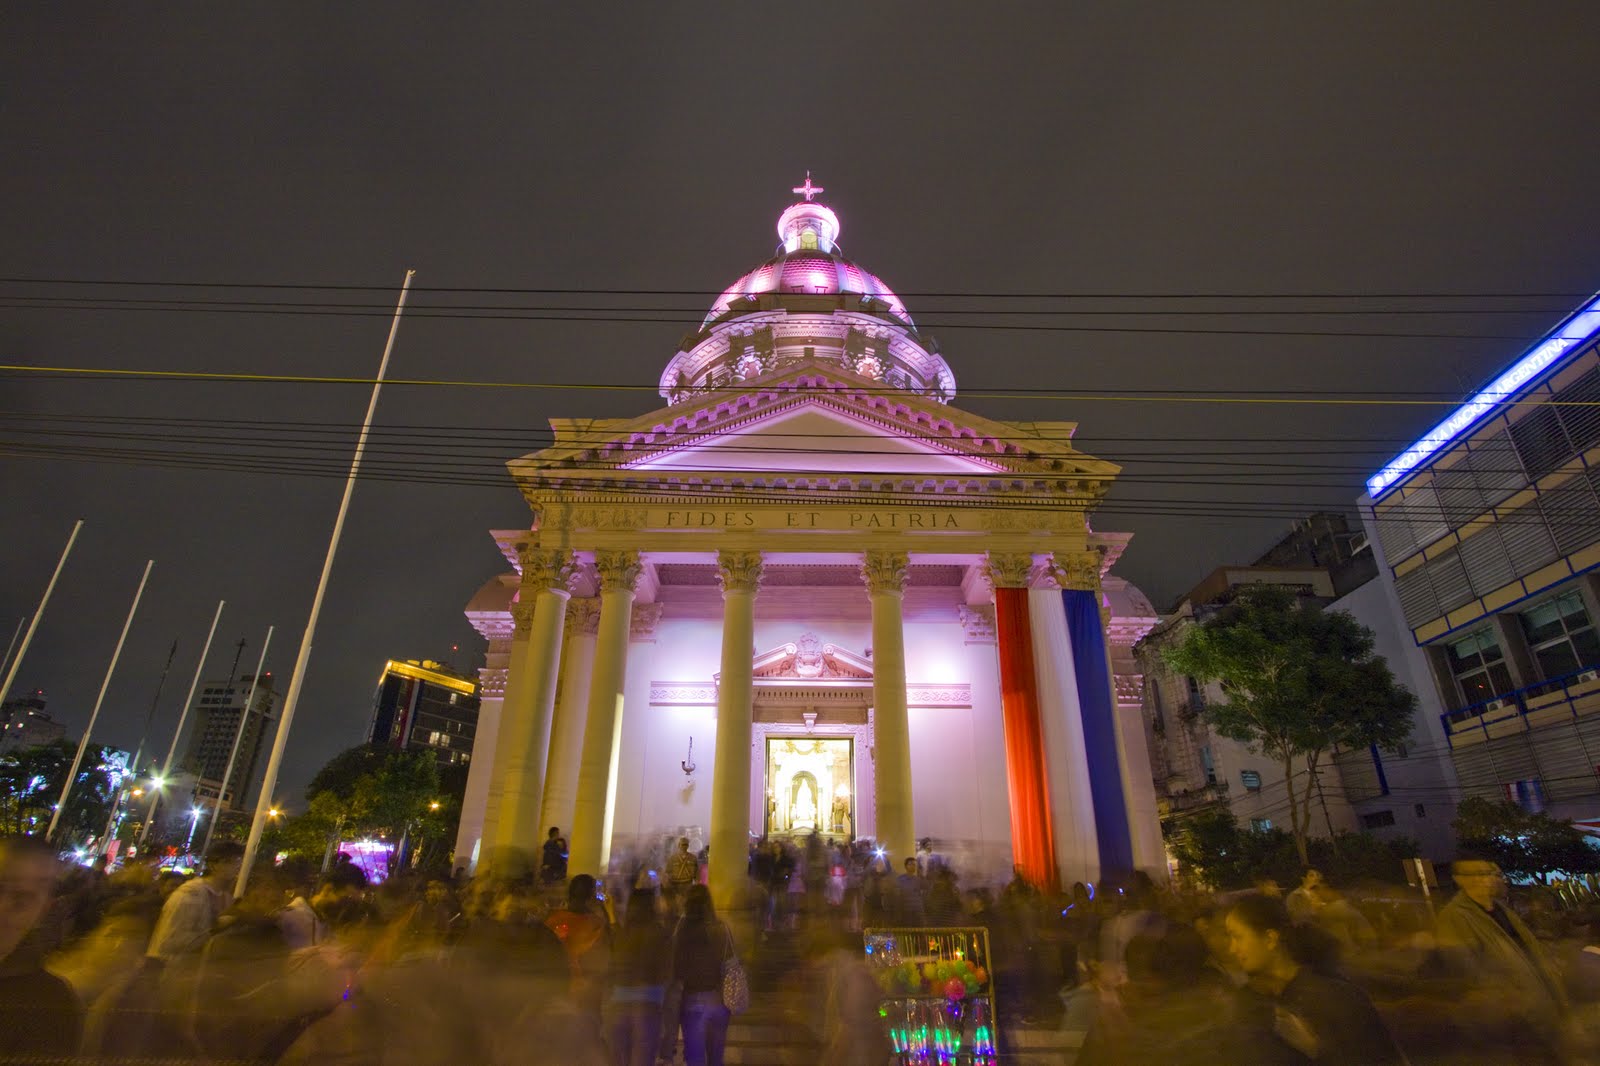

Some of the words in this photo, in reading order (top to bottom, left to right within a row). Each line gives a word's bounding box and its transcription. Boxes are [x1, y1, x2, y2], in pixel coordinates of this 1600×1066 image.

[1433, 429, 1449, 445] LA
[1496, 338, 1570, 398] ARGENTINA
[666, 511, 754, 527] FIDES
[787, 512, 821, 527] ET
[850, 513, 959, 528] PATRIA
